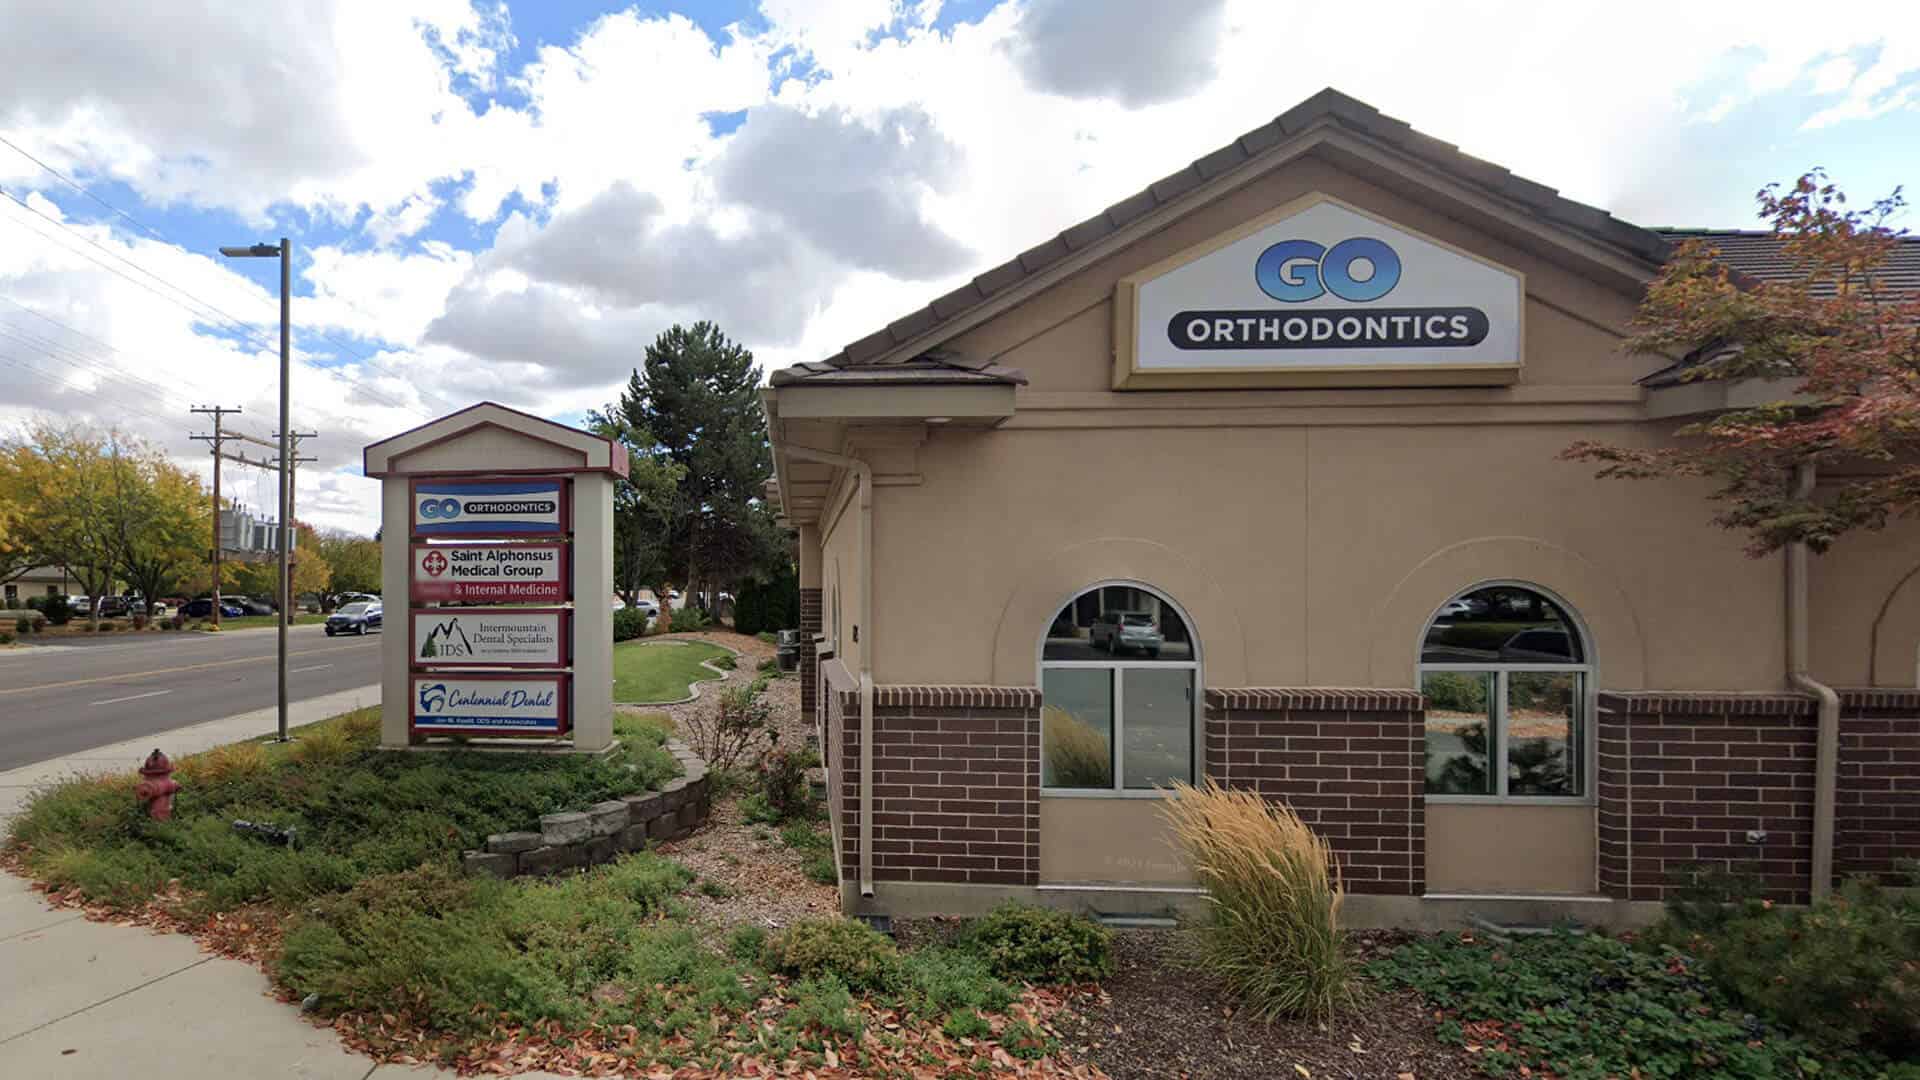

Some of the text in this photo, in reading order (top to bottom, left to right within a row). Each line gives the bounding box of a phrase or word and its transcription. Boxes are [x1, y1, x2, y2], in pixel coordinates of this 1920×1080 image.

[1255, 236, 1402, 303] GO
[1186, 316, 1469, 342] ORTHODONTICS
[420, 498, 551, 519] GO ORTHODONTICS
[451, 550, 553, 563] Saint Alphonsus
[451, 566, 543, 578] Medical Group
[465, 584, 507, 595] Internal
[509, 584, 558, 595] Medicine
[480, 622, 546, 633] Intermountain
[473, 633, 553, 646] Dental Specialists
[440, 644, 464, 657] IDS
[448, 689, 554, 709] Centennial Dental
